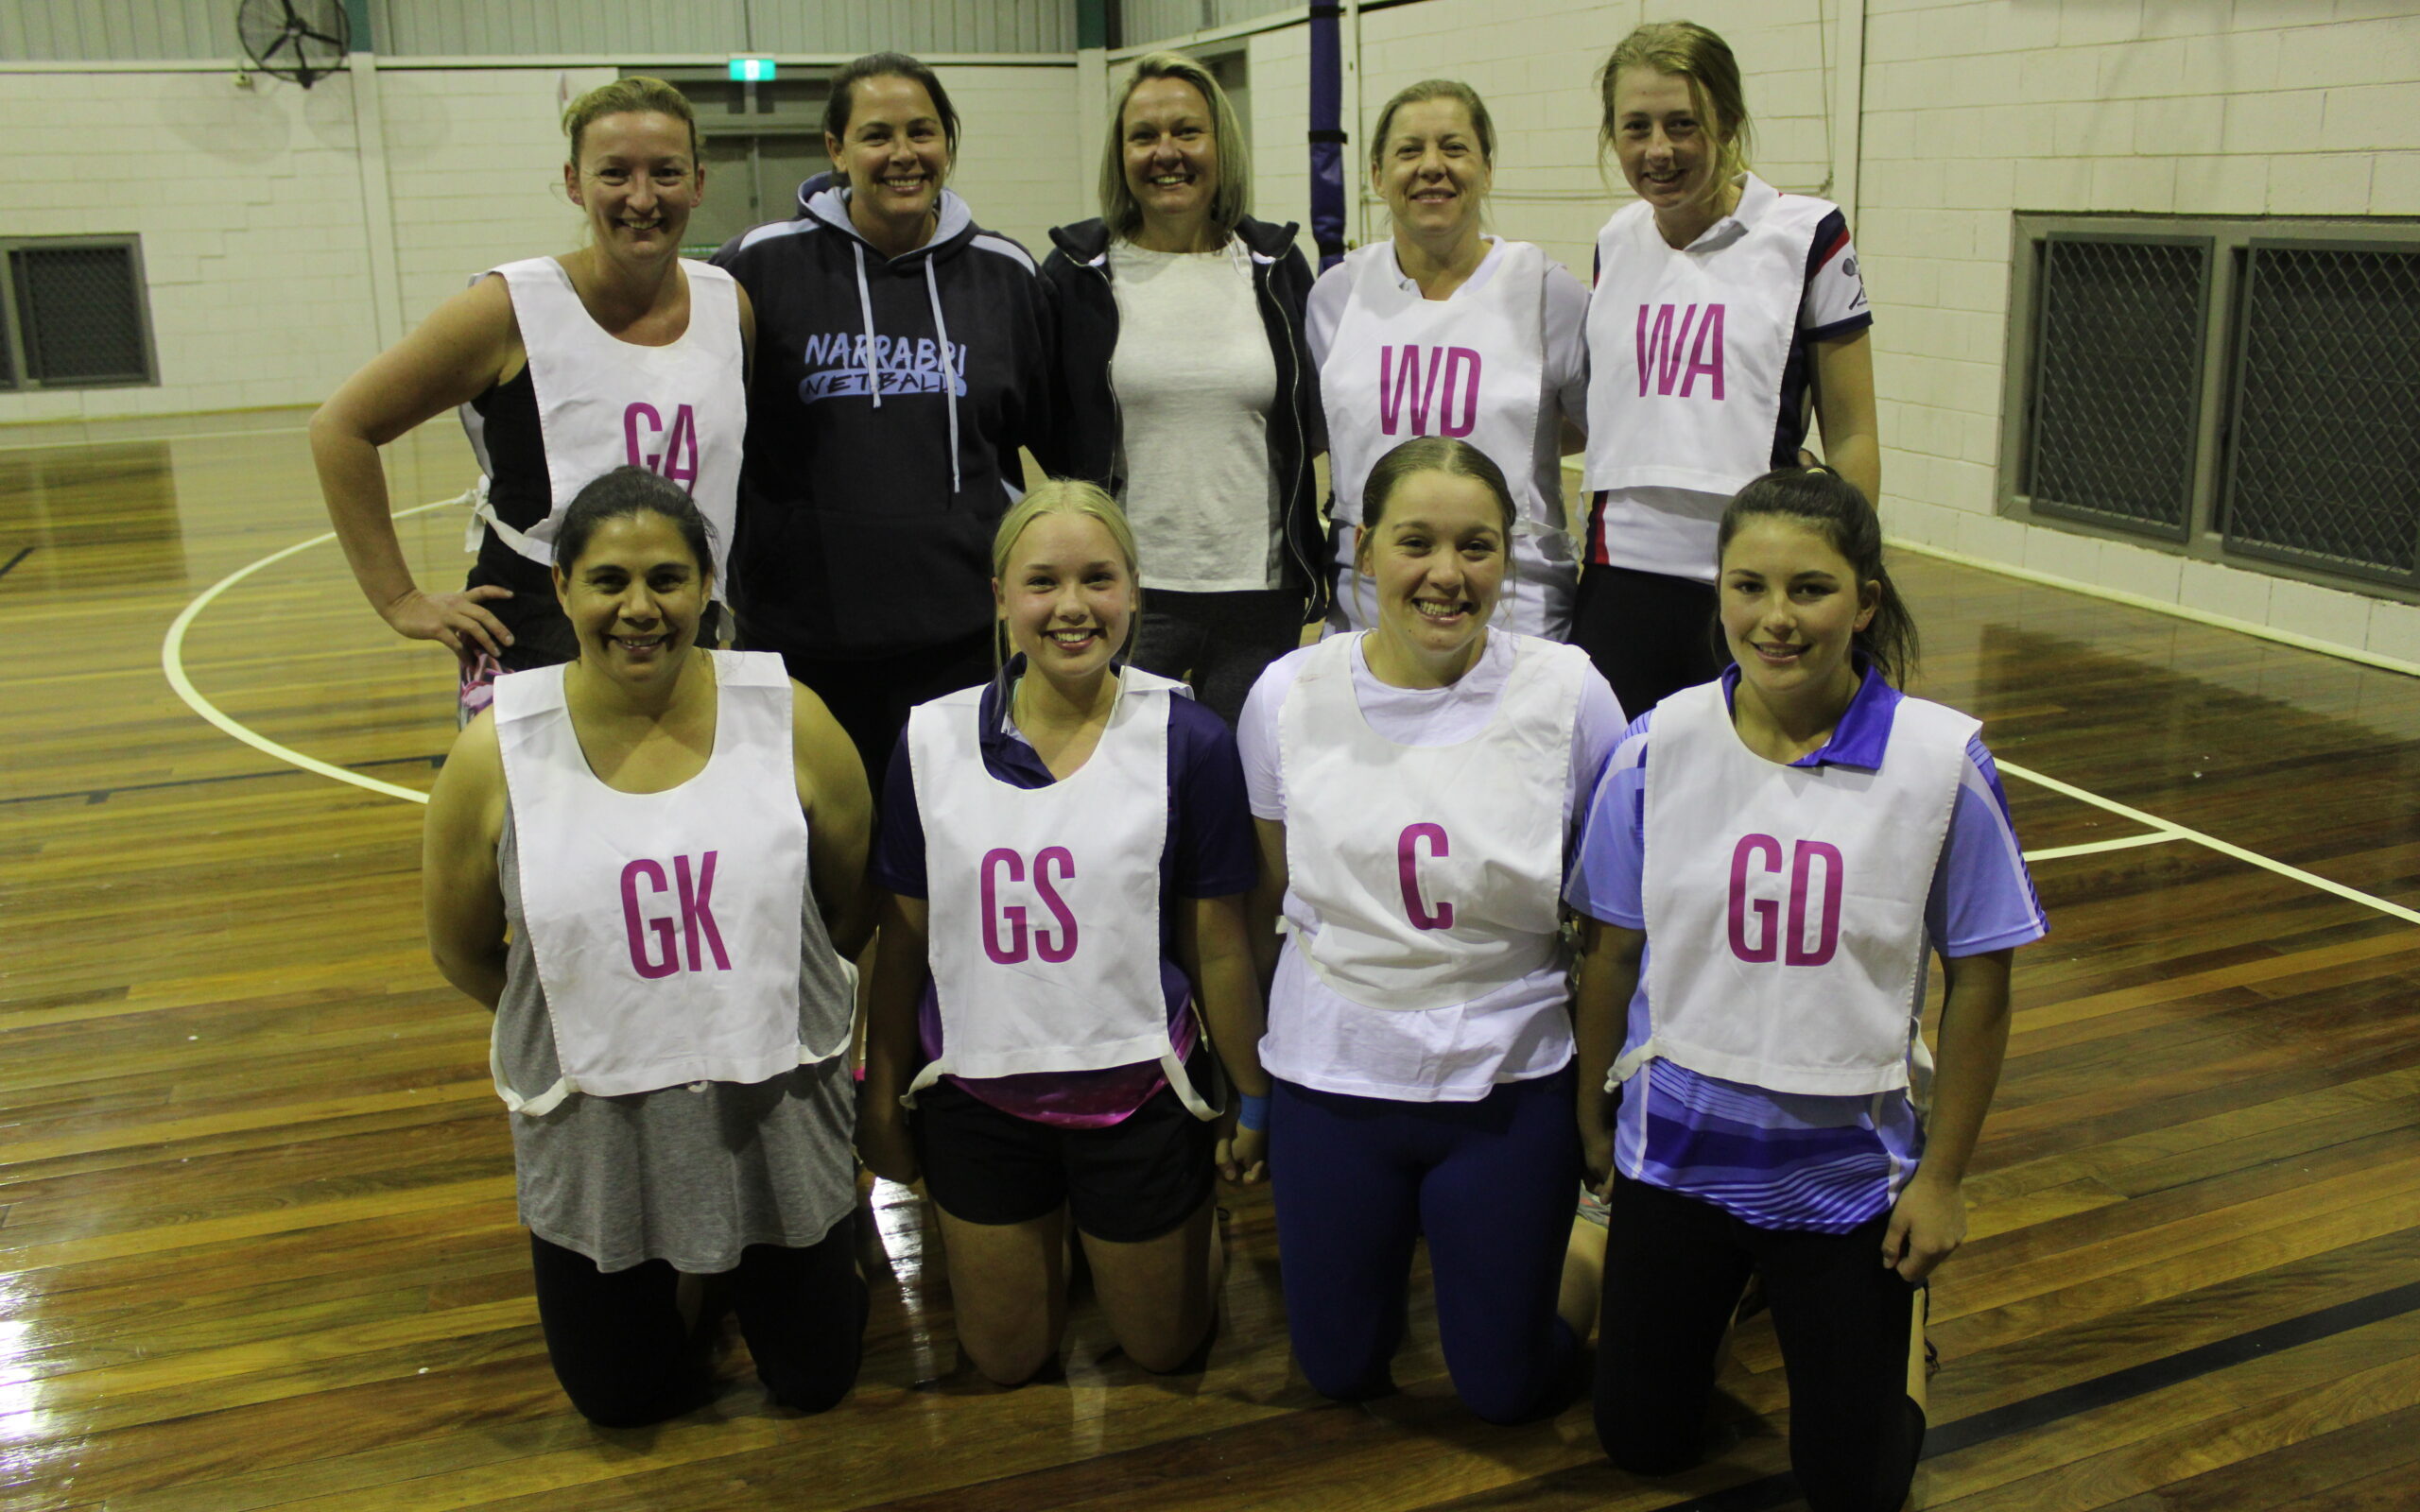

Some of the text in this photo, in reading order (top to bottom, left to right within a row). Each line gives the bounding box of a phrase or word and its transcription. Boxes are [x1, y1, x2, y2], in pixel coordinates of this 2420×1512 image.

[804, 332, 966, 377] NARRABRI
[805, 371, 957, 394] NETBALL
[1380, 345, 1481, 438] WD
[1636, 303, 1725, 401] WA
[624, 402, 699, 496] GA
[620, 850, 732, 979] GK
[980, 846, 1078, 965] GS
[1397, 822, 1453, 931] C
[1727, 833, 1843, 967] GD
